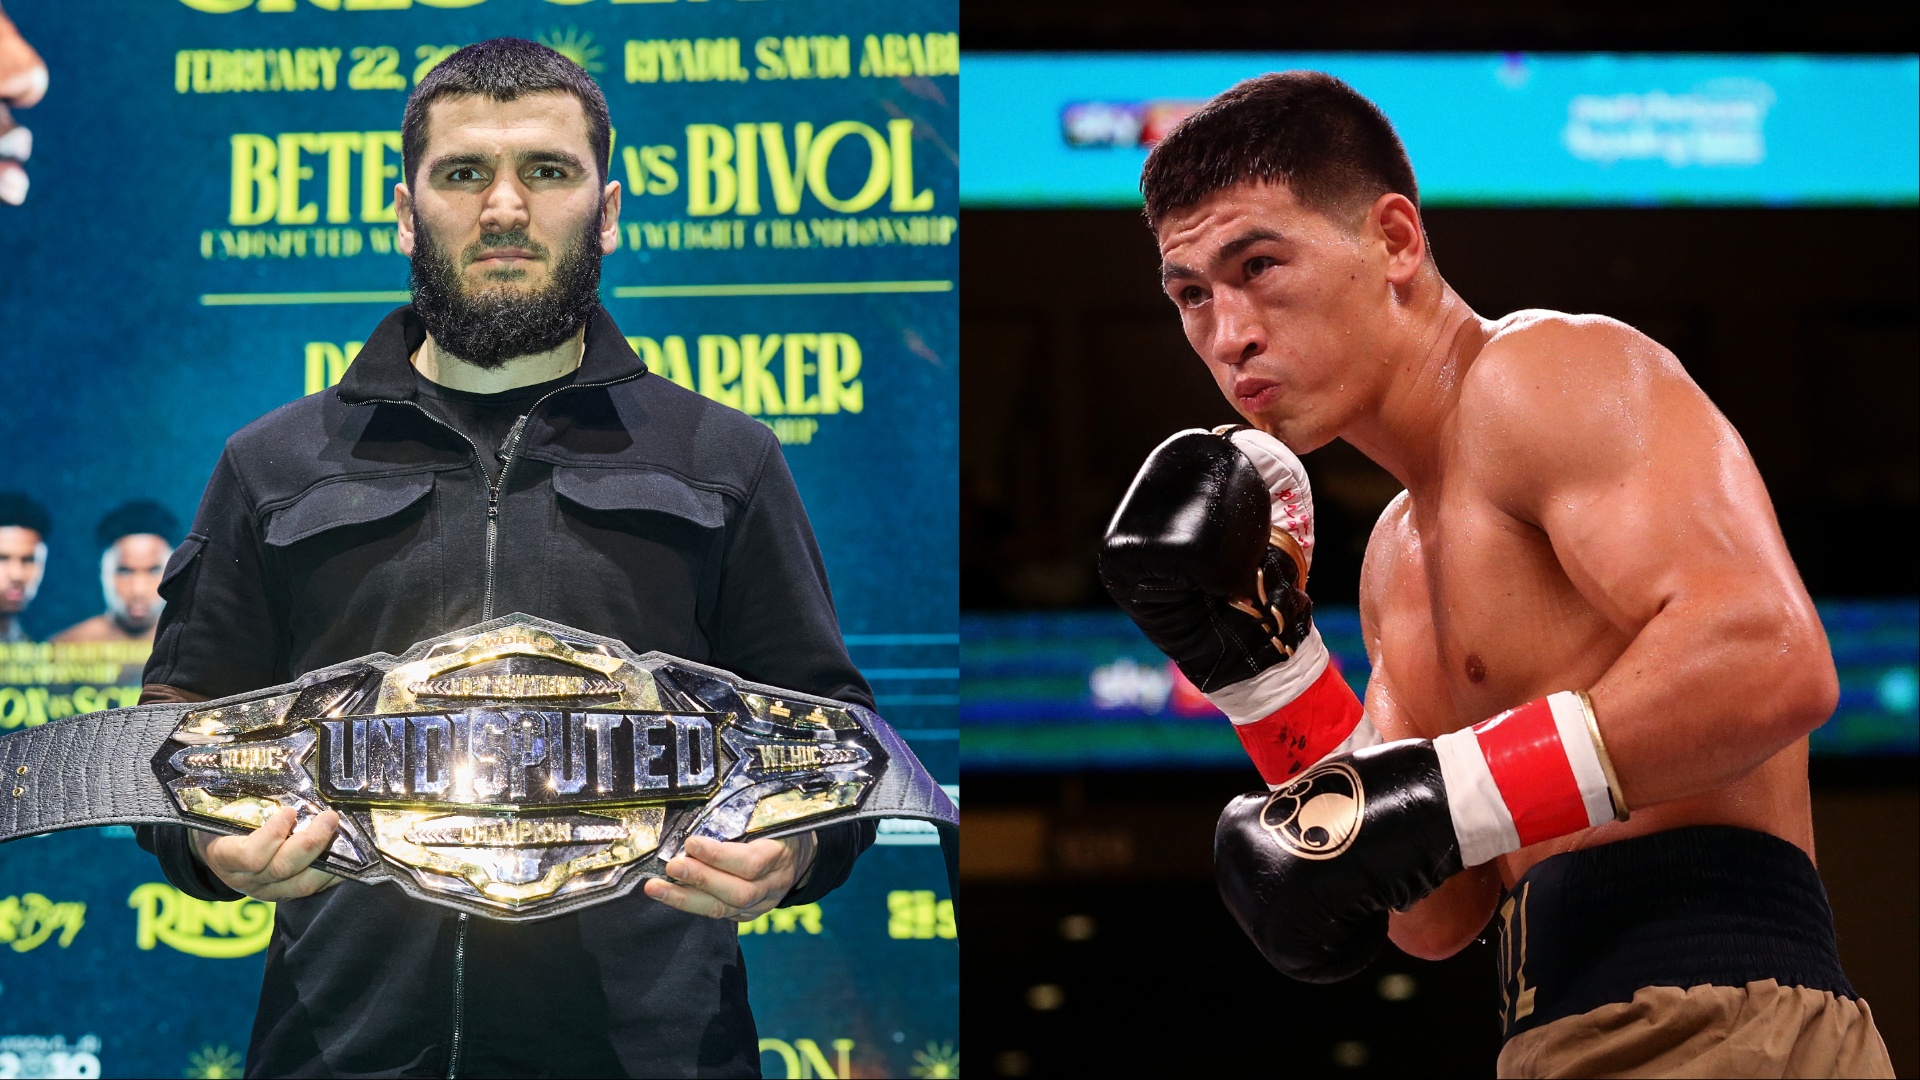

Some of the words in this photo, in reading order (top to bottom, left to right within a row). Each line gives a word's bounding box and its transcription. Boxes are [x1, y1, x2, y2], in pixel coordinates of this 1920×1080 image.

[175, 48, 342, 94] FEBRUARY
[755, 35, 850, 80] SAUDI
[859, 32, 959, 78] ARABI
[229, 130, 404, 226] BETE
[684, 119, 935, 217] BIVOL
[484, 635, 555, 649] WORLD
[324, 708, 716, 800] UNDISPUTED
[460, 820, 572, 842] CHAMPION
